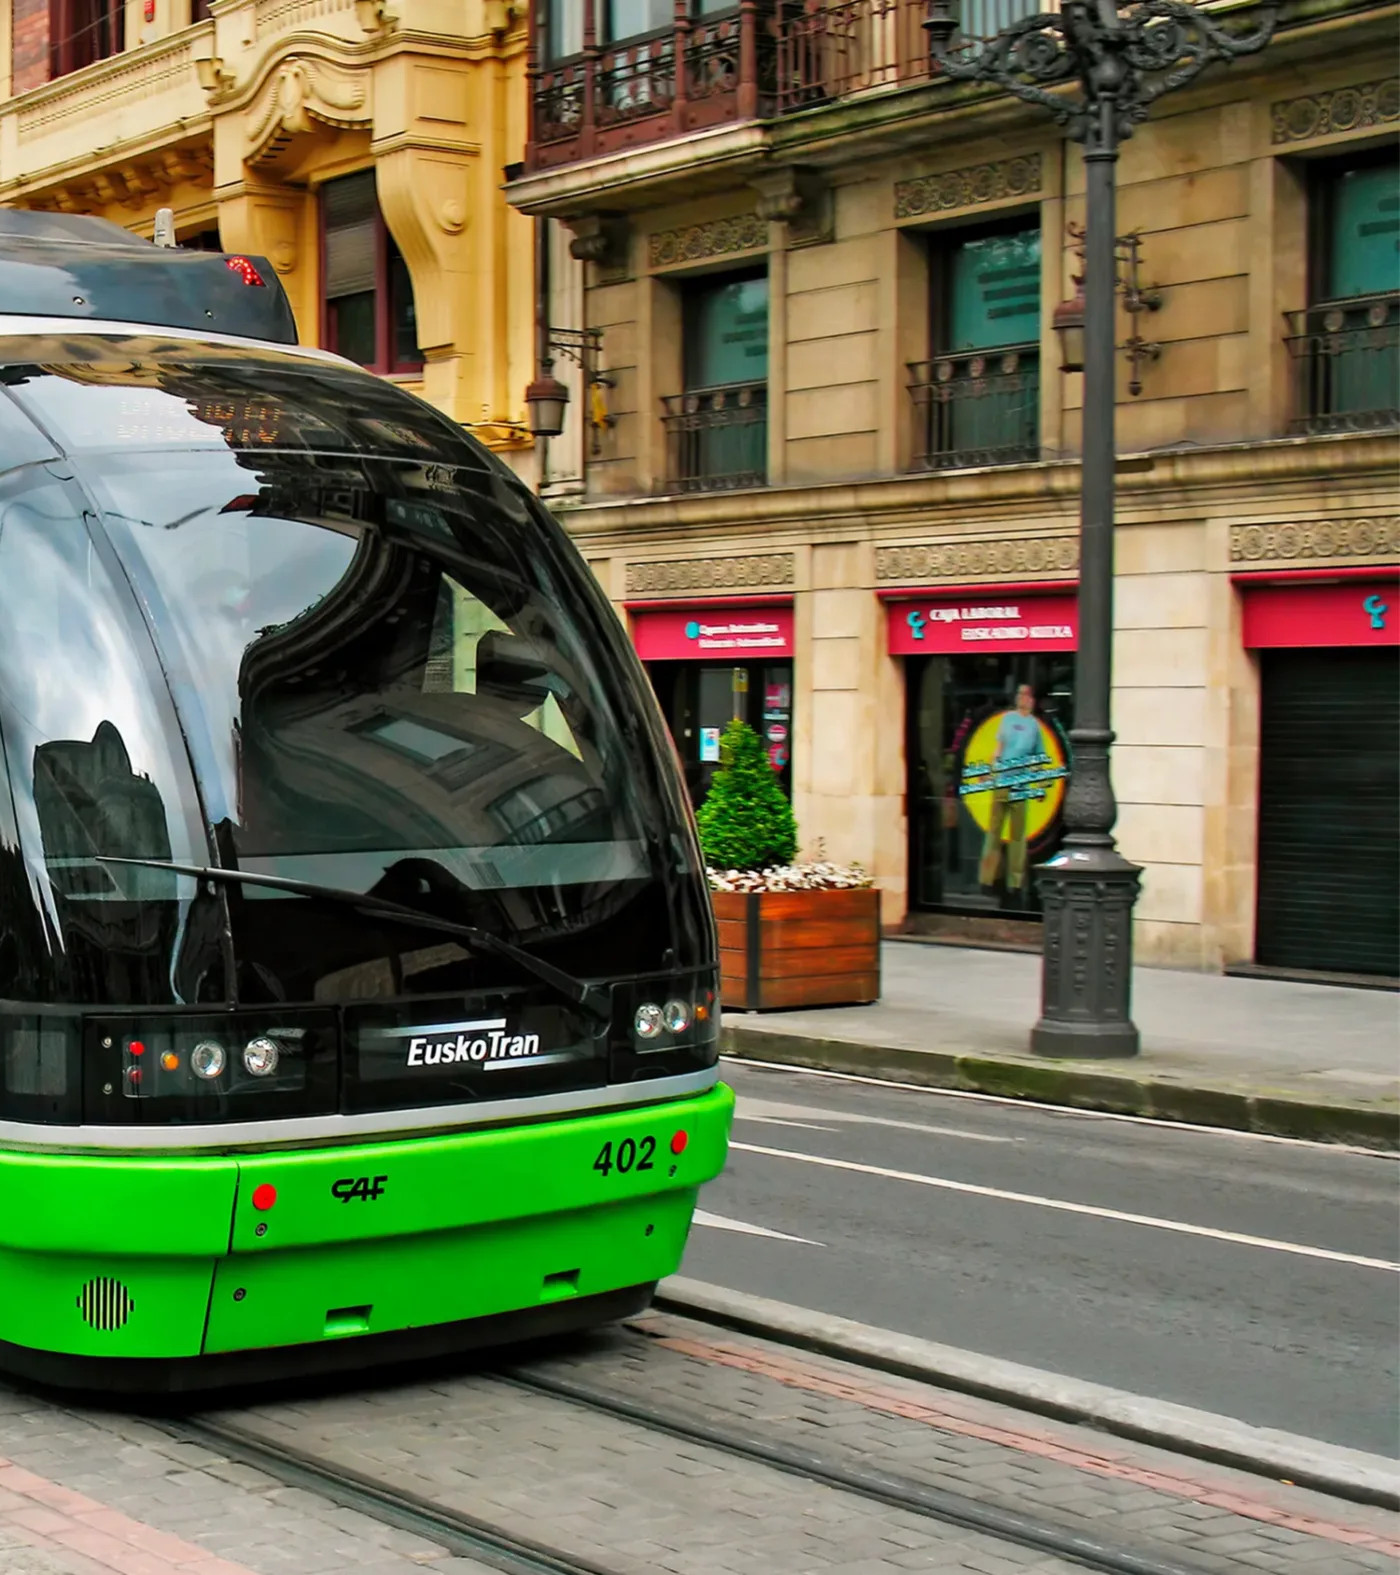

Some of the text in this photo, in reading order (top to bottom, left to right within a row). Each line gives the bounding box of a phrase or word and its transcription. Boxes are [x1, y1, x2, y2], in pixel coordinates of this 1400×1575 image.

[407, 1031, 540, 1067] EuskoTran
[592, 1135, 657, 1177] 402
[331, 1174, 388, 1204] CAF
